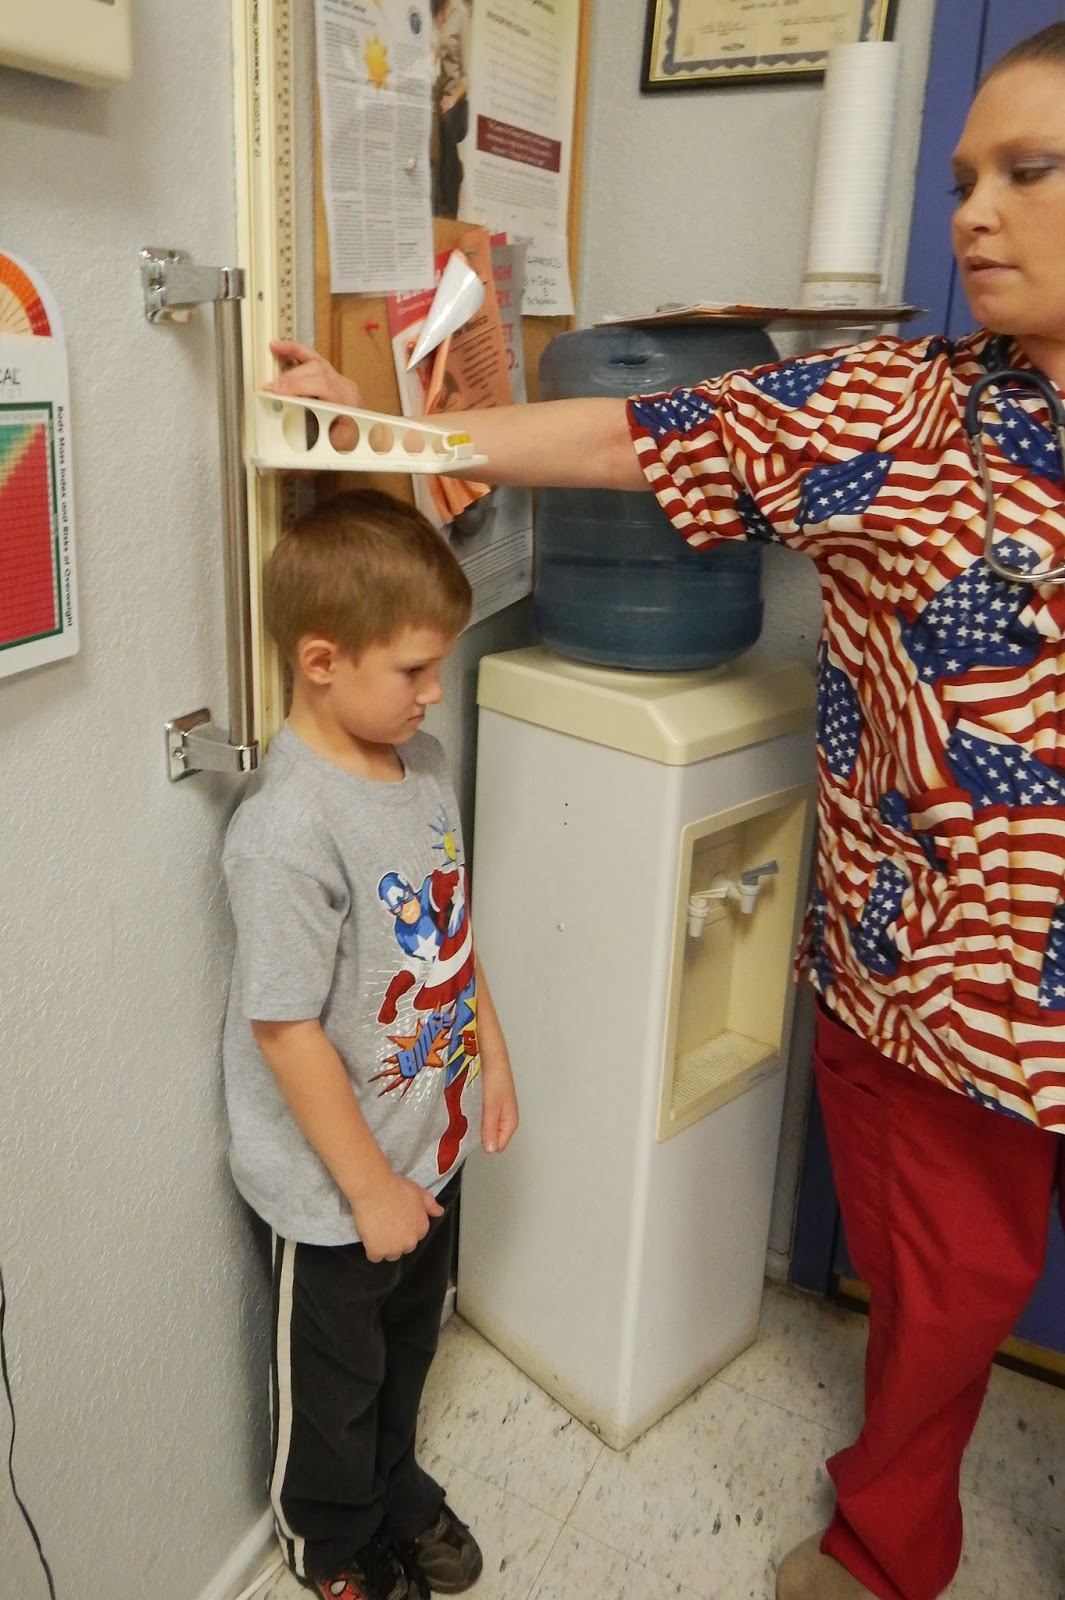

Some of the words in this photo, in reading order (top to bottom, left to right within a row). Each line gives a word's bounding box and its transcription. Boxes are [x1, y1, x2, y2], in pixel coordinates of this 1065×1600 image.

[56, 406, 64, 433] Body
[58, 436, 66, 464] Mass
[62, 526, 70, 552] Risks
[64, 568, 73, 627] Overweight
